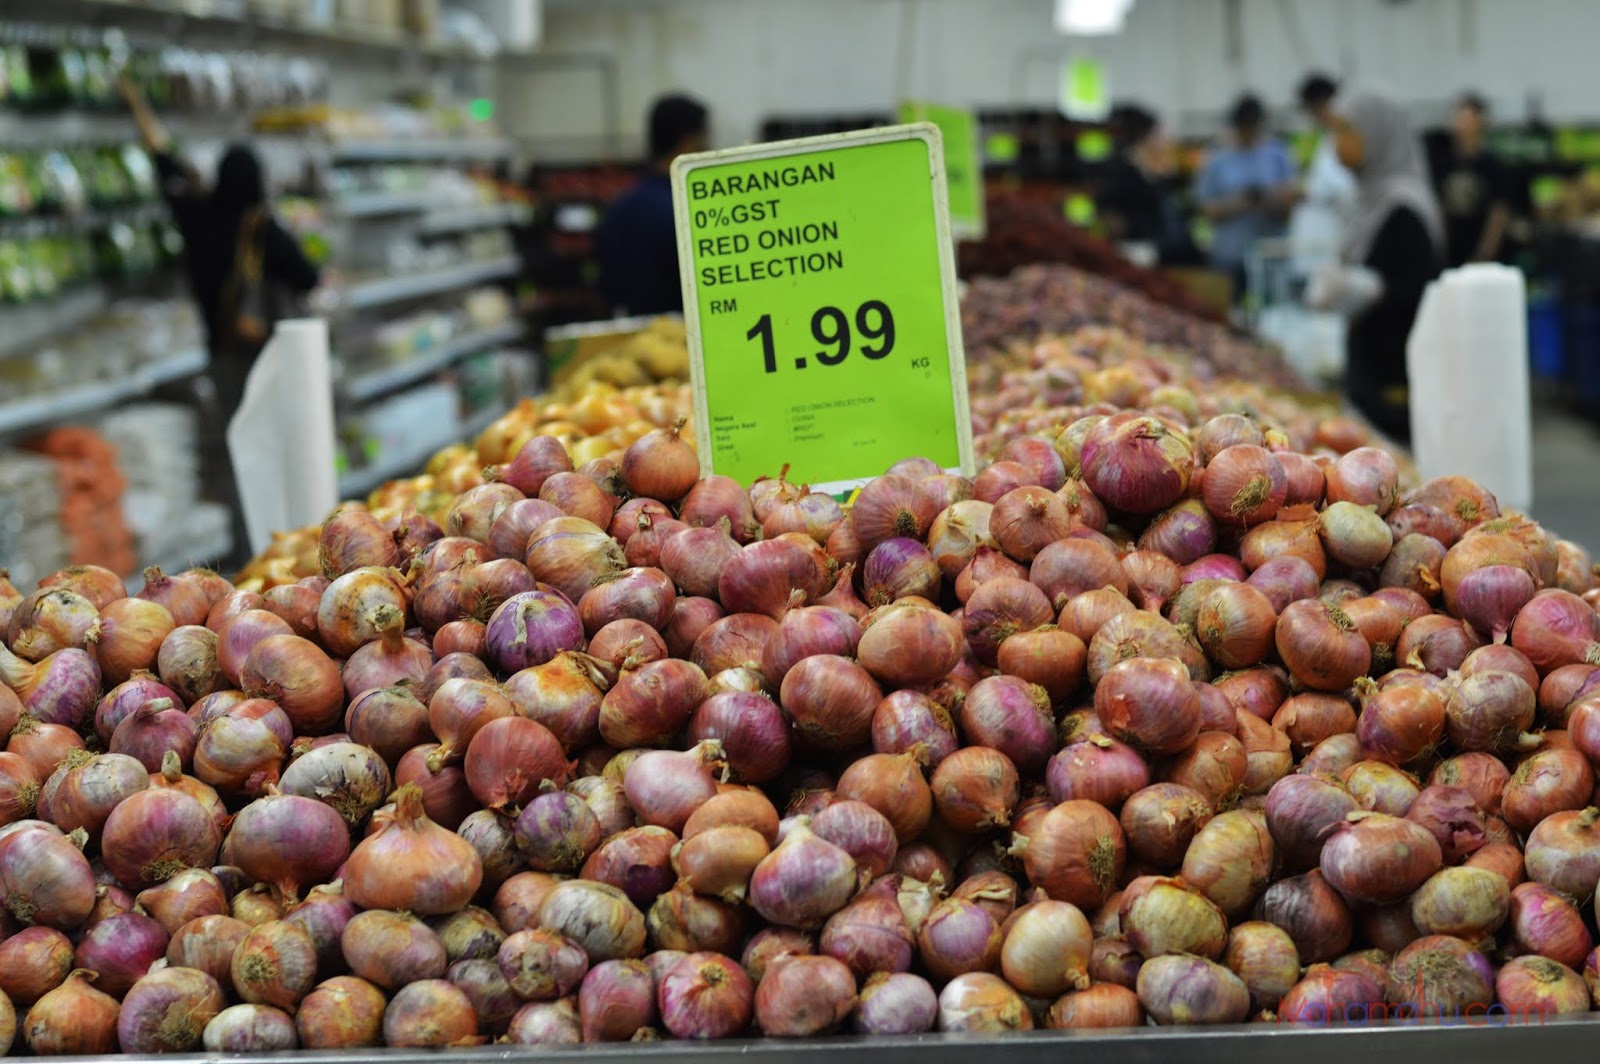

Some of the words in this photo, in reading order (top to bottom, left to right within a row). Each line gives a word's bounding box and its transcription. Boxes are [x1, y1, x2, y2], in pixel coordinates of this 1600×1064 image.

[692, 161, 836, 201] BARANGAN
[695, 200, 780, 229] 0%GST
[698, 234, 750, 258] RED
[758, 221, 839, 251] ONION
[701, 250, 844, 287] SELECTION
[710, 298, 738, 315] RM
[746, 300, 896, 374] 1.99
[911, 356, 930, 369] KG
[833, 396, 875, 407] SELECTION
